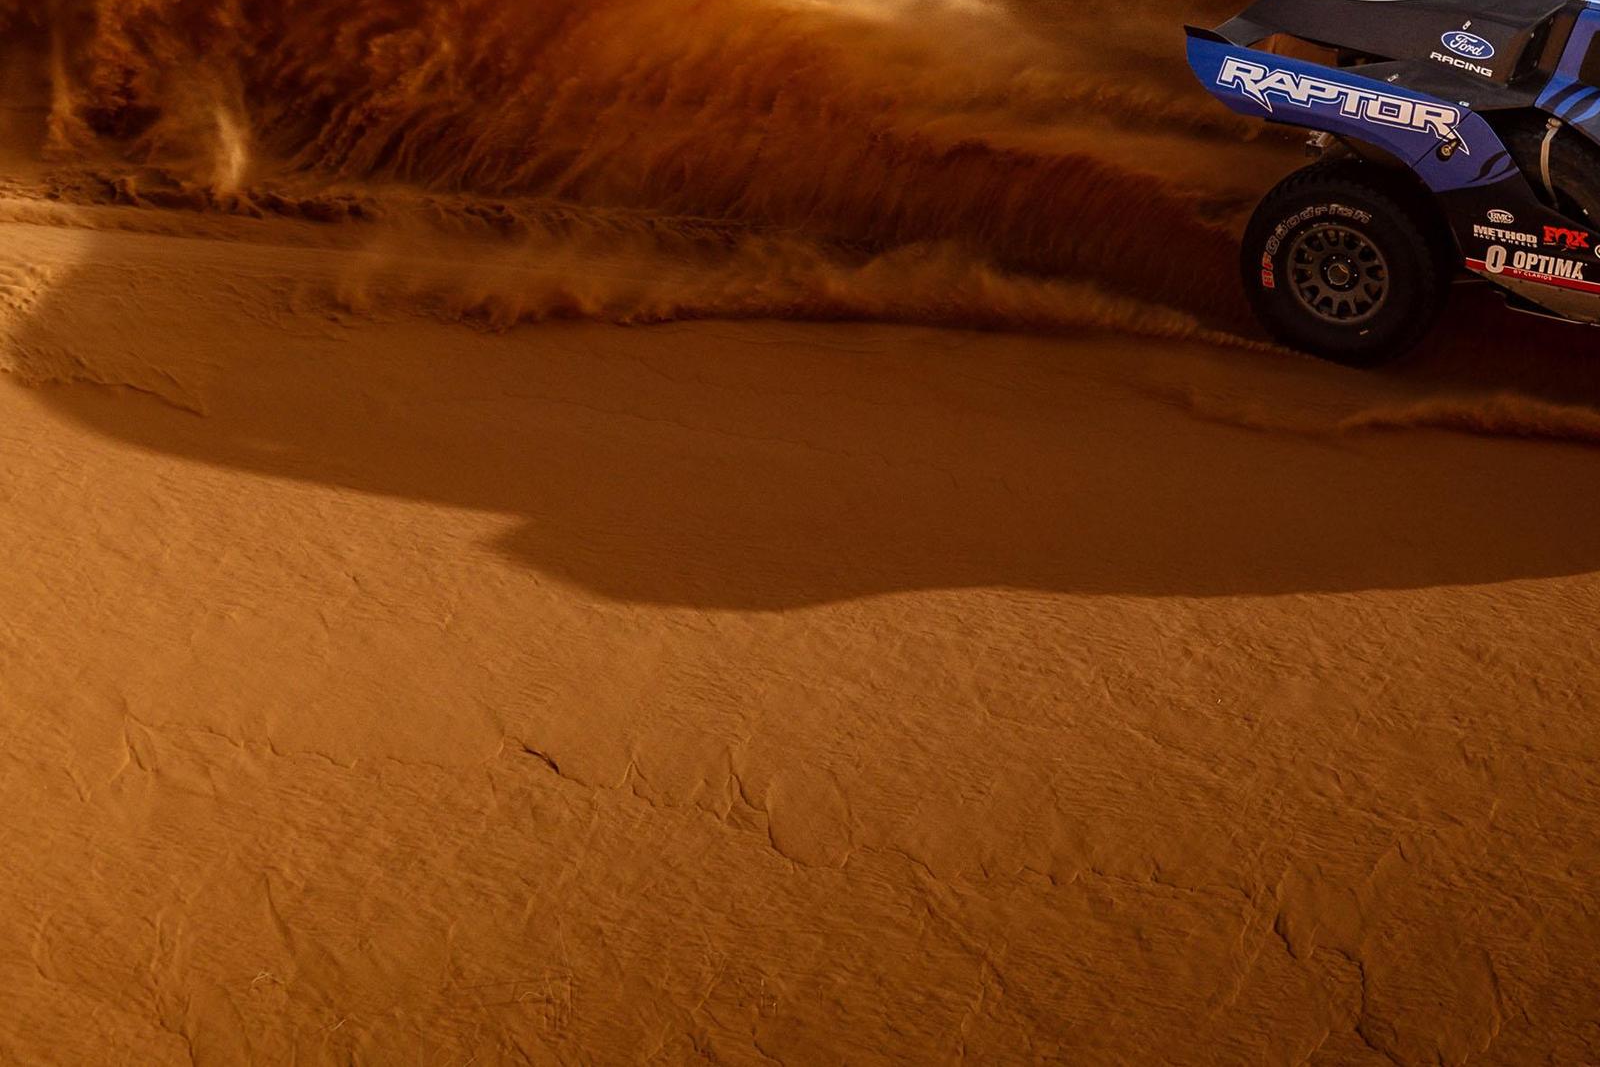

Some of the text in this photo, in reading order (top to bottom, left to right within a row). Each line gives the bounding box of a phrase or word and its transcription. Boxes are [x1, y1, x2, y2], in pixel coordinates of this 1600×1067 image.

[1449, 34, 1485, 56] Ford
[1430, 51, 1494, 77] RACING
[1216, 56, 1470, 156] RAPTOR
[1473, 224, 1538, 244] METHOD
[1500, 238, 1538, 248] WHEELS
[1543, 225, 1589, 249] FOX
[1512, 250, 1584, 280] OPTIMA
